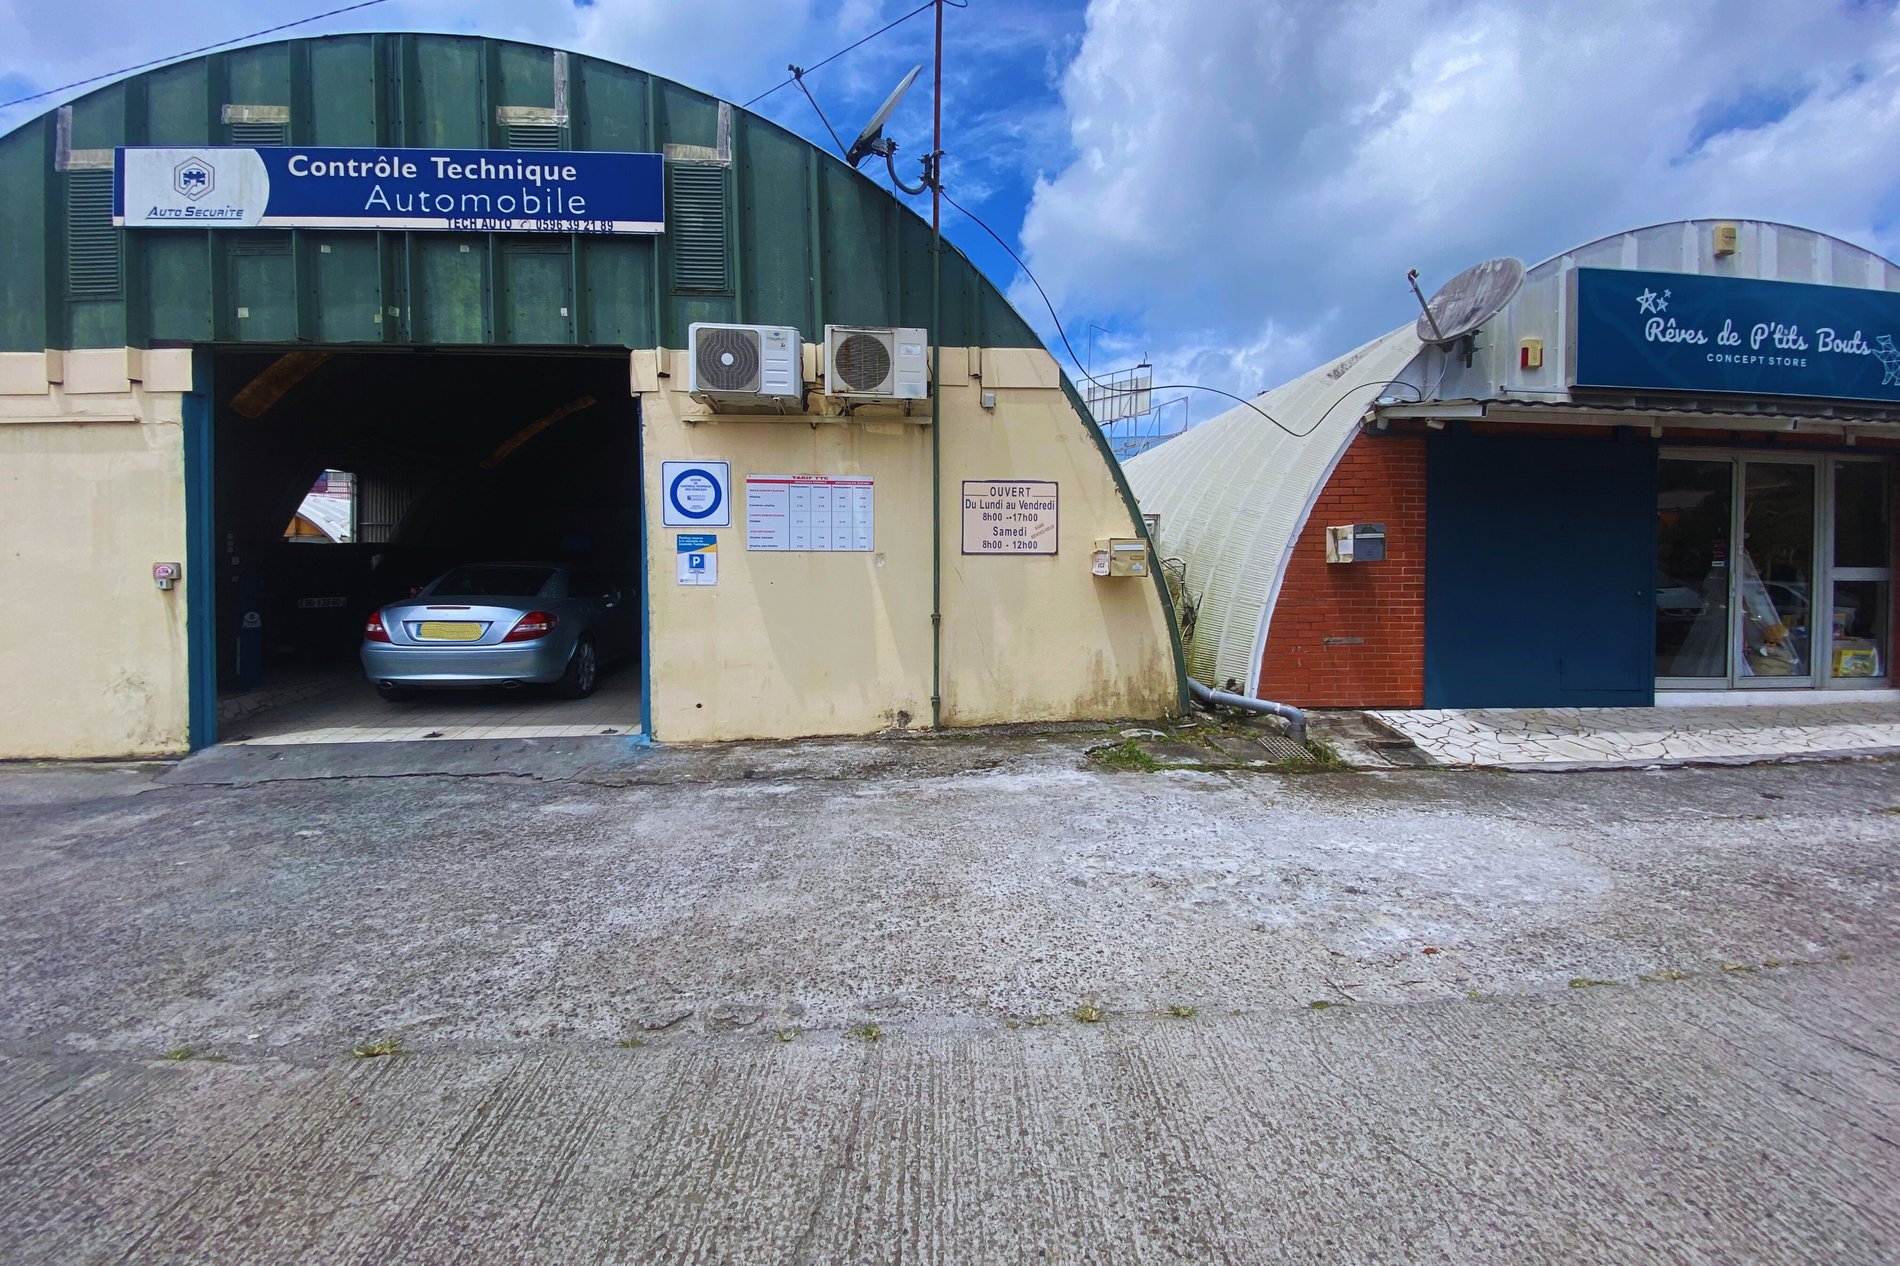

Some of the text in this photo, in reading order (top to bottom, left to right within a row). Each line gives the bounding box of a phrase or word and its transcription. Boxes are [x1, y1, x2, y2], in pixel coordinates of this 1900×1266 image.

[288, 155, 577, 186] Contrôle Technique
[364, 184, 586, 214] Automobile
[448, 219, 512, 229] TECH AUTO
[536, 219, 614, 233] 0596 39 21 89
[1645, 317, 1872, 355] Rêves de P'tits Bouts
[1706, 353, 1808, 367] CONCEPT STORE
[989, 486, 1032, 498] OUVERT
[965, 499, 1055, 511] Du Lundi au Vendredi
[982, 512, 1003, 522] 8h00
[1013, 513, 1038, 522] 17h00
[992, 526, 1027, 537] Samedi
[982, 540, 1003, 549] 8h00
[1012, 540, 1038, 550] 12h00
[693, 556, 701, 567] P
